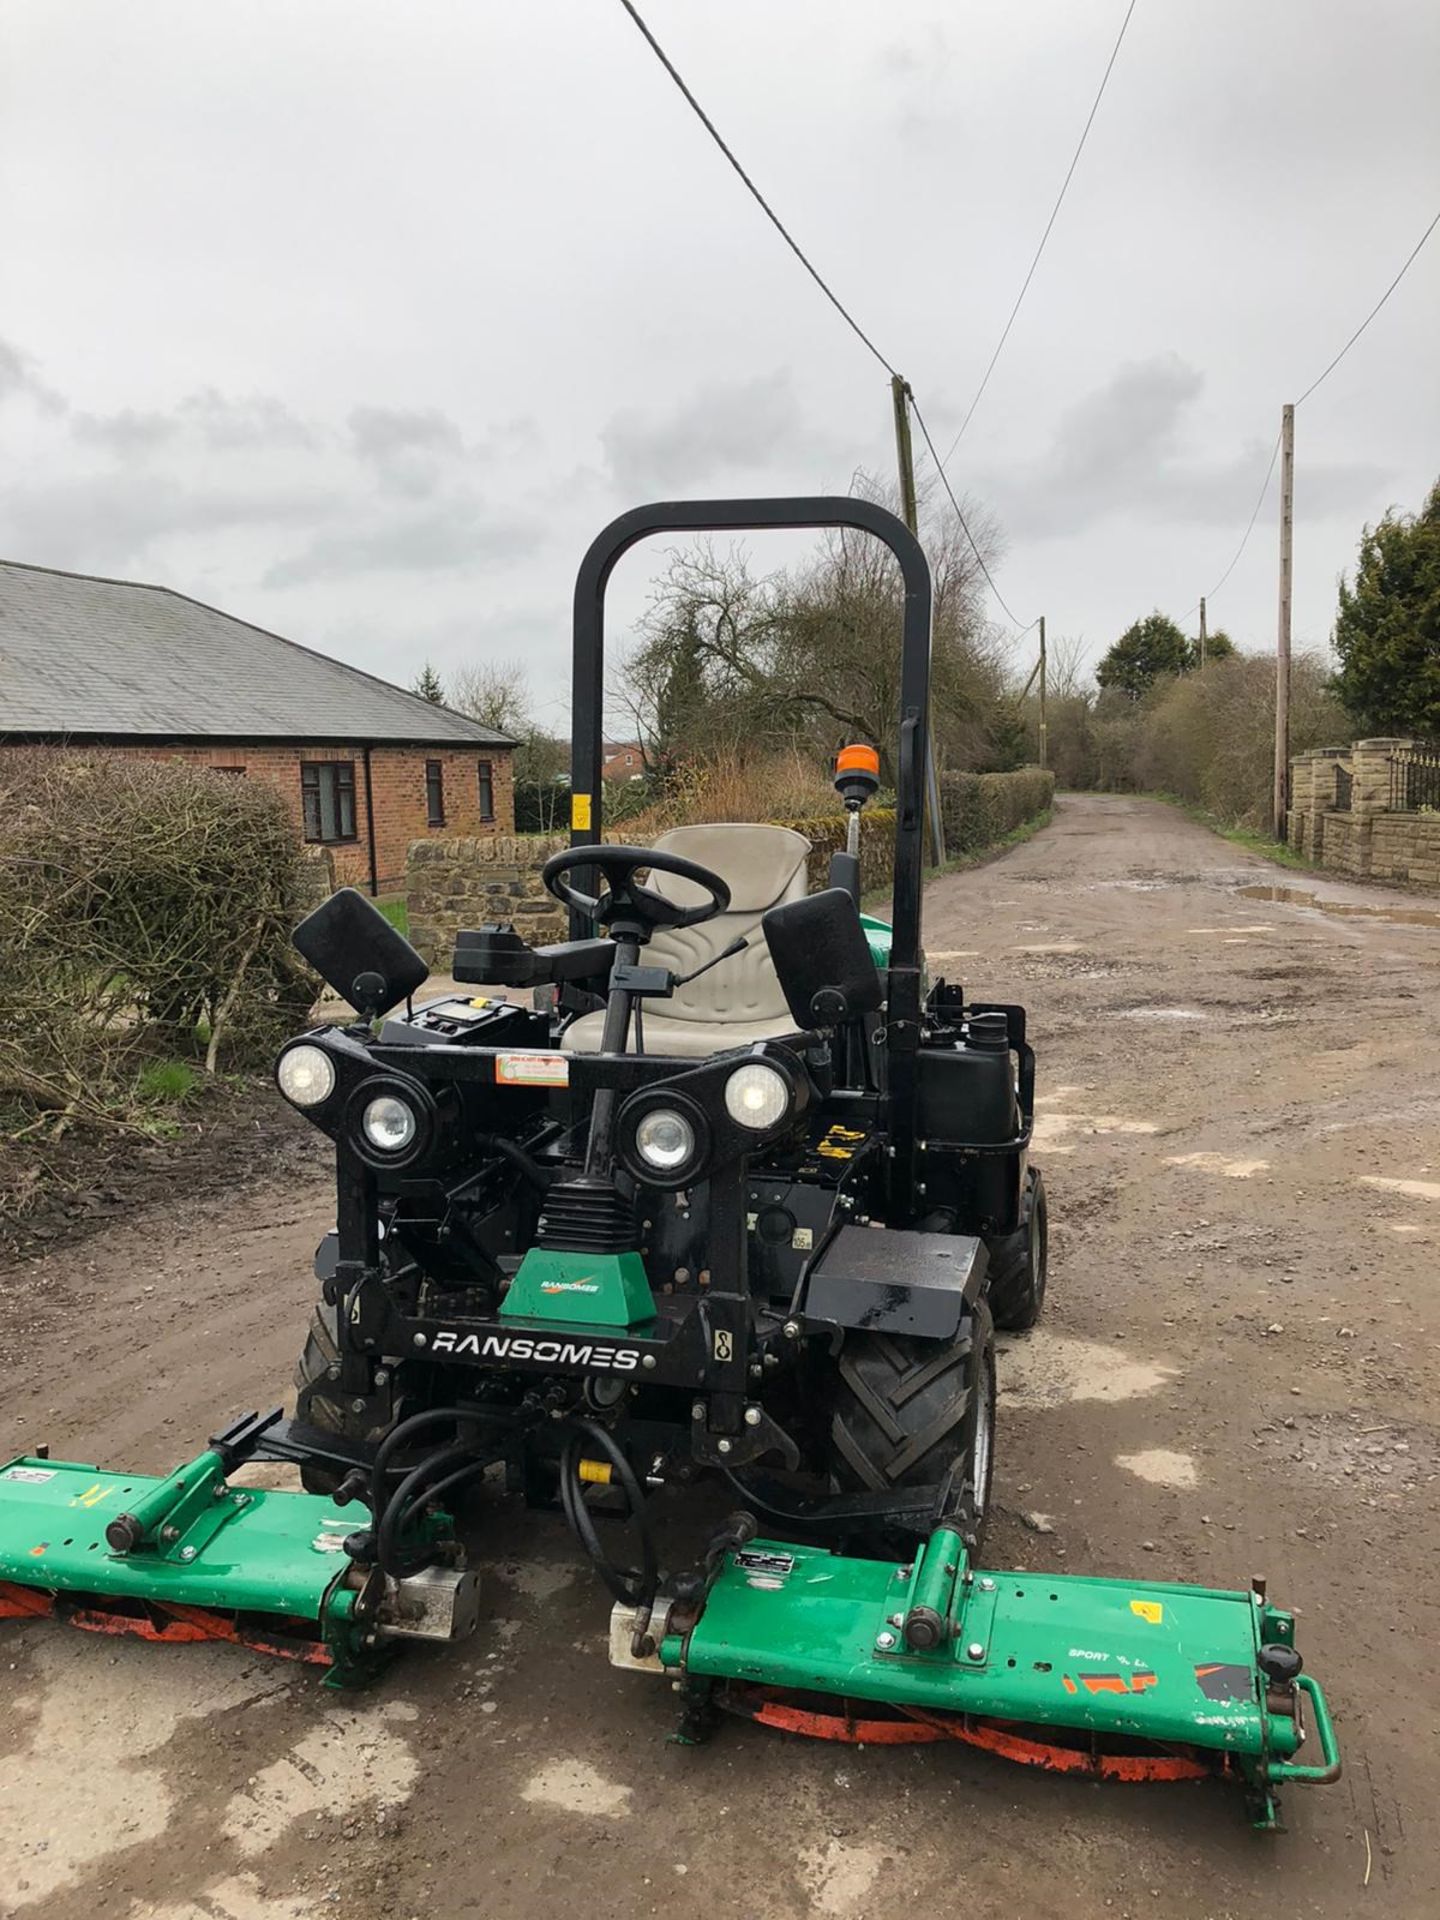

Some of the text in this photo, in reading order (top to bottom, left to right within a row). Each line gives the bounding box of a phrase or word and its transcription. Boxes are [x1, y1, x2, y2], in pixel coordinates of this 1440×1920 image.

[541, 1280, 600, 1293] RANSOMES
[432, 1331, 640, 1370] RANSOMES
[1068, 1648, 1110, 1661] SPORT
